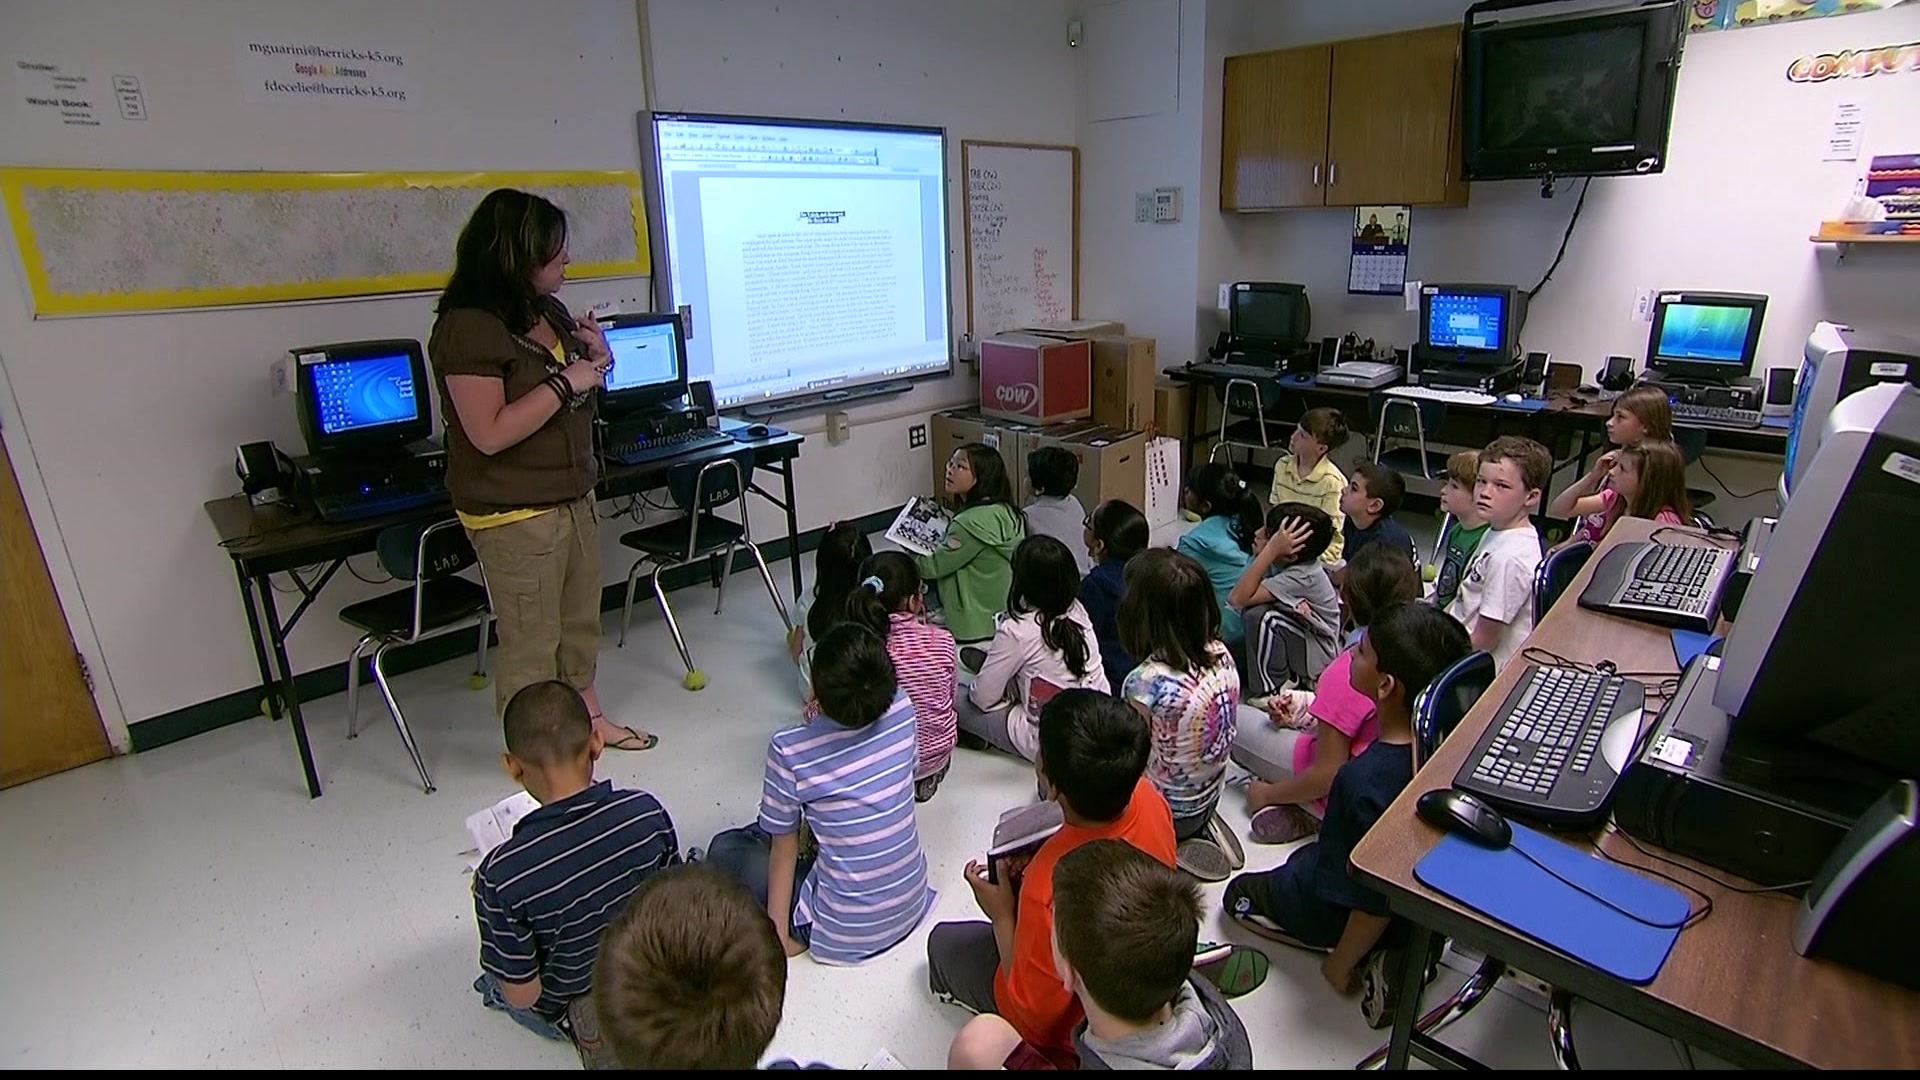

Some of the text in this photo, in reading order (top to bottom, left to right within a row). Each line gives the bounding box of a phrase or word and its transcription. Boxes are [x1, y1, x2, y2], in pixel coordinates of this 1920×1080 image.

[249, 42, 403, 66] mguarini@herricks-k5.org
[295, 62, 318, 76] Google
[336, 66, 367, 78] Addresses
[265, 80, 406, 101] fdecelie@herricks-k5.org
[26, 97, 58, 106] World
[592, 302, 611, 310] HELP
[996, 385, 1030, 404] CDW
[1394, 424, 1410, 433] LAB
[709, 488, 730, 502] LAB
[434, 553, 460, 571] LAB
